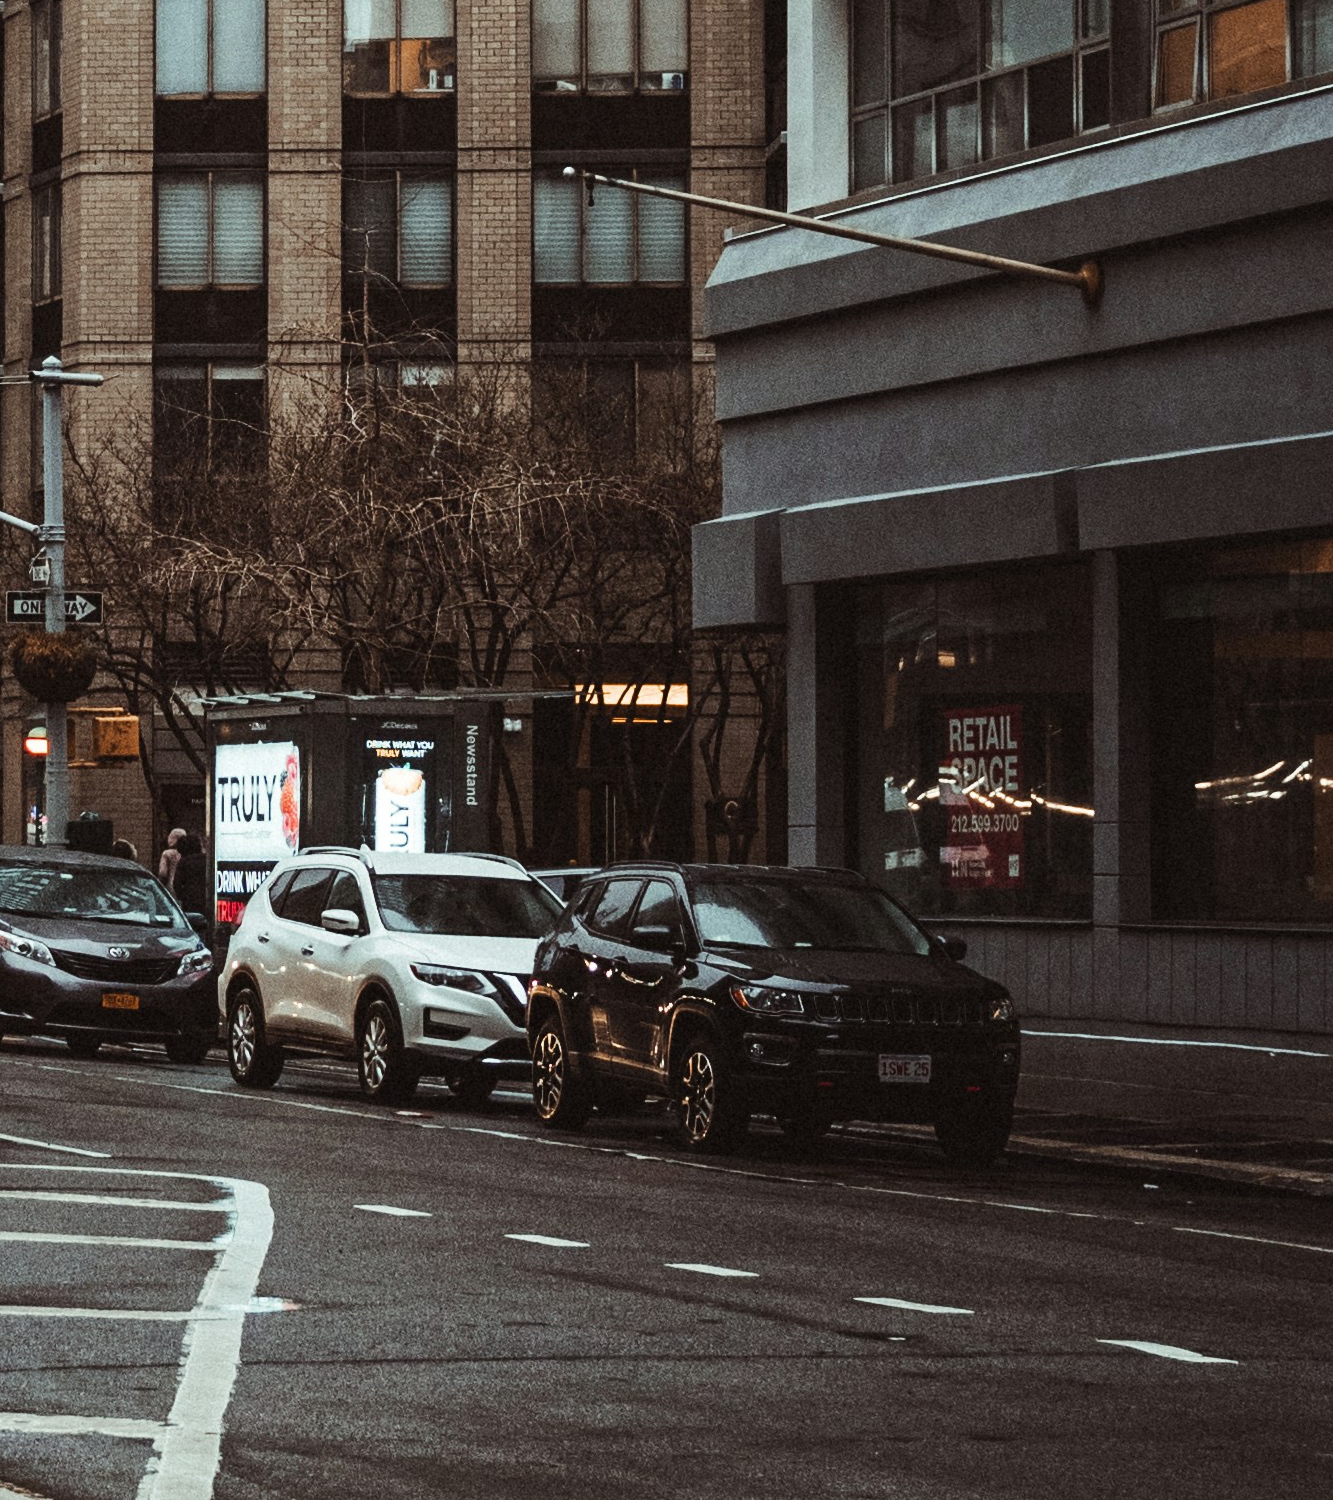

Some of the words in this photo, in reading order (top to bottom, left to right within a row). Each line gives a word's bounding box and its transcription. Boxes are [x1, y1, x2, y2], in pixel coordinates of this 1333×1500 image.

[21, 601, 39, 613] ON
[366, 740, 391, 748] DRINK
[392, 740, 415, 749] WHAT
[416, 741, 435, 750] YOU
[949, 716, 1018, 752] RETAIL
[375, 748, 400, 758] TRULY
[466, 725, 478, 806] Newsstand
[950, 756, 1018, 792] SPACE
[218, 775, 276, 822] TRULY
[390, 800, 409, 852] ULY
[951, 814, 1019, 832] 212.599.3700
[217, 870, 245, 893] DRINK
